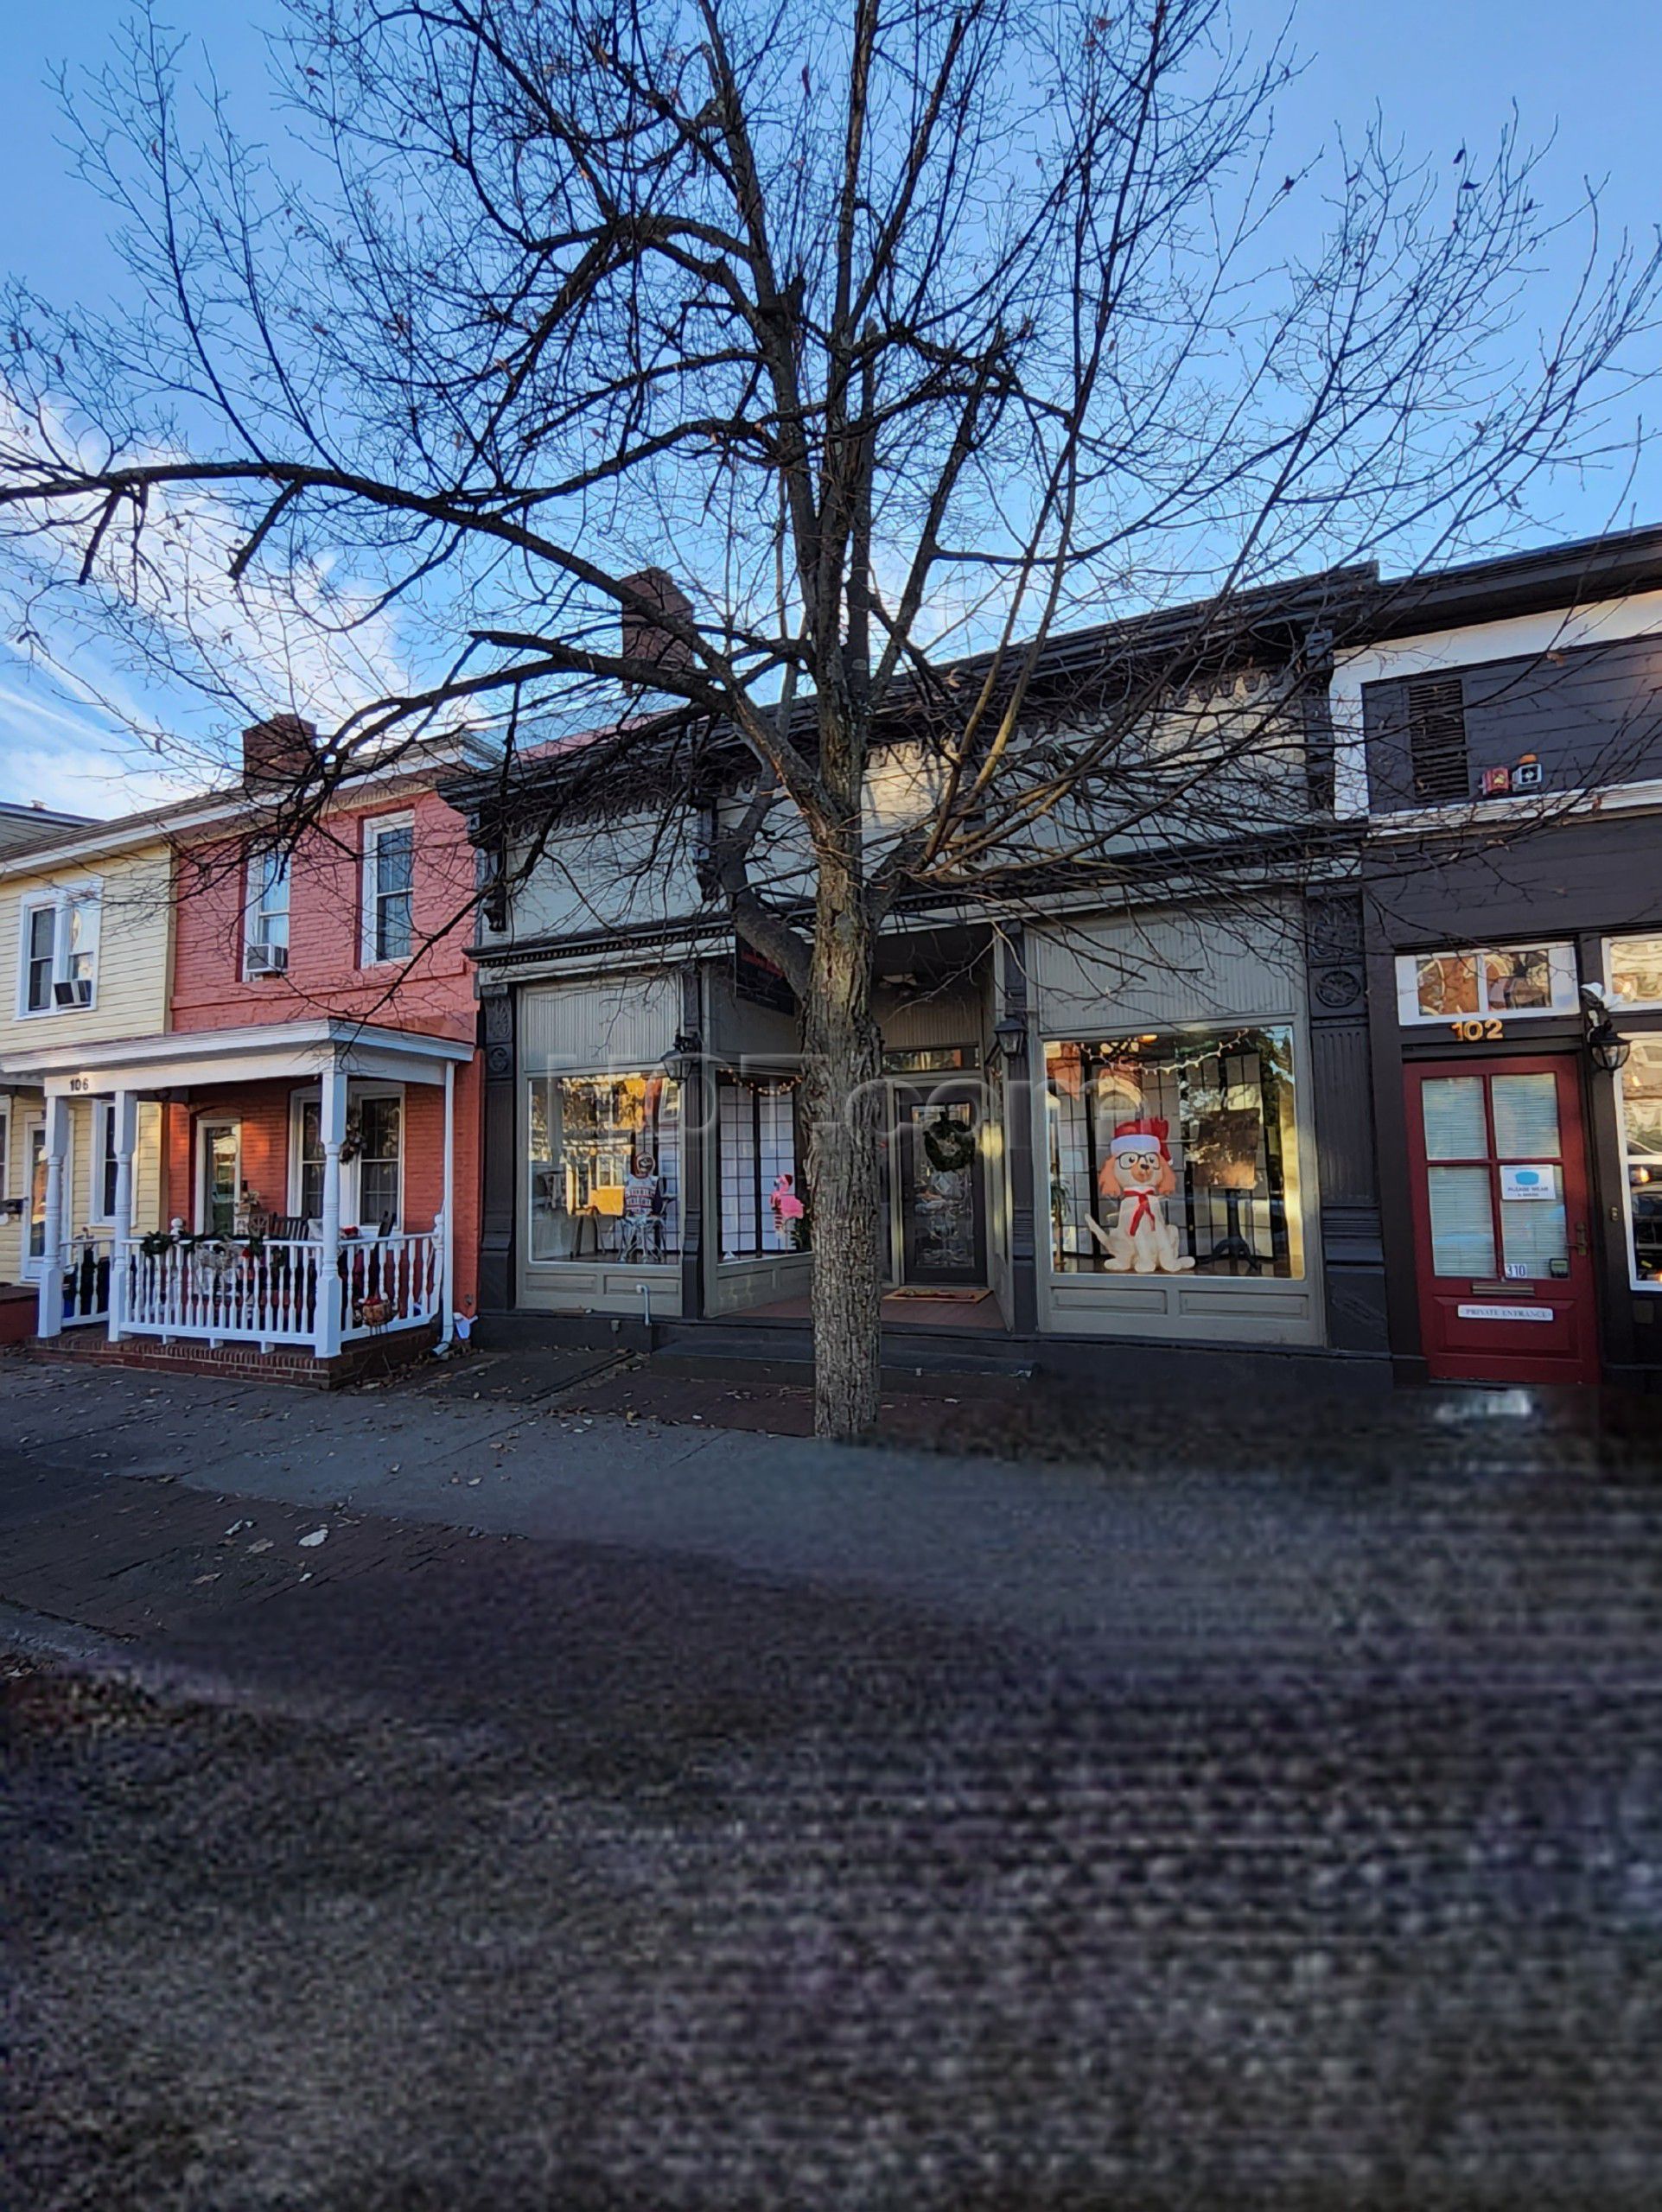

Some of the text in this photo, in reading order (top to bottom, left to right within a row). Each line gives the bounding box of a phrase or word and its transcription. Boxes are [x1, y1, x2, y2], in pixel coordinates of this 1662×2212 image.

[1451, 1018, 1504, 1041] 102
[70, 1077, 89, 1091] 106
[1506, 1264, 1526, 1277] 310
[1465, 1308, 1547, 1319] PRIVATE ENTRANCE
